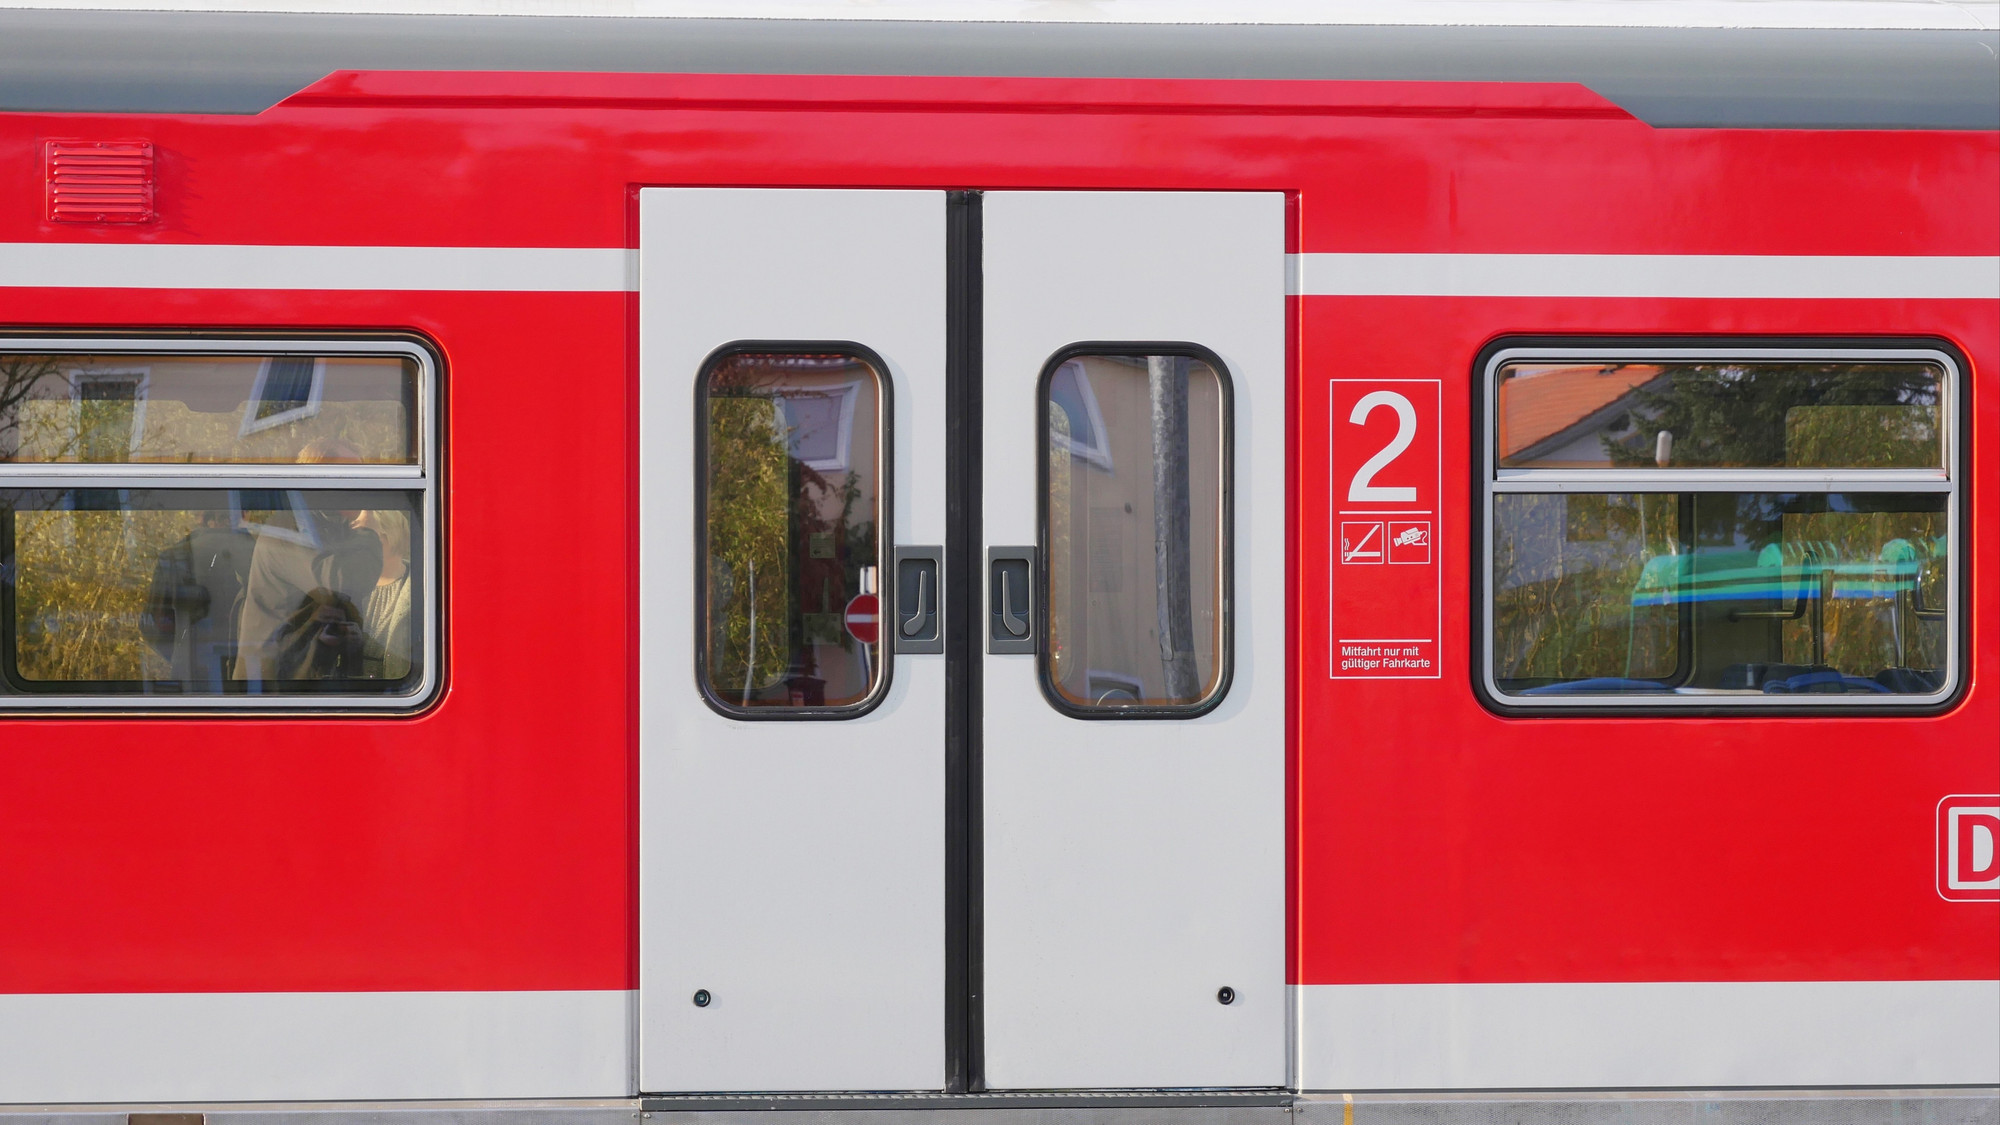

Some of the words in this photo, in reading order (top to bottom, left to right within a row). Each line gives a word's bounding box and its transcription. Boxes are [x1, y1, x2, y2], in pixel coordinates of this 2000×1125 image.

[1348, 390, 1417, 502] 2
[1341, 646, 1381, 656] Mitfahrt
[1383, 648, 1401, 656] nur
[1402, 646, 1419, 656] mit
[1341, 658, 1381, 670] gültiger
[1382, 658, 1431, 668] Fahrkarte
[1958, 814, 2000, 882] D
